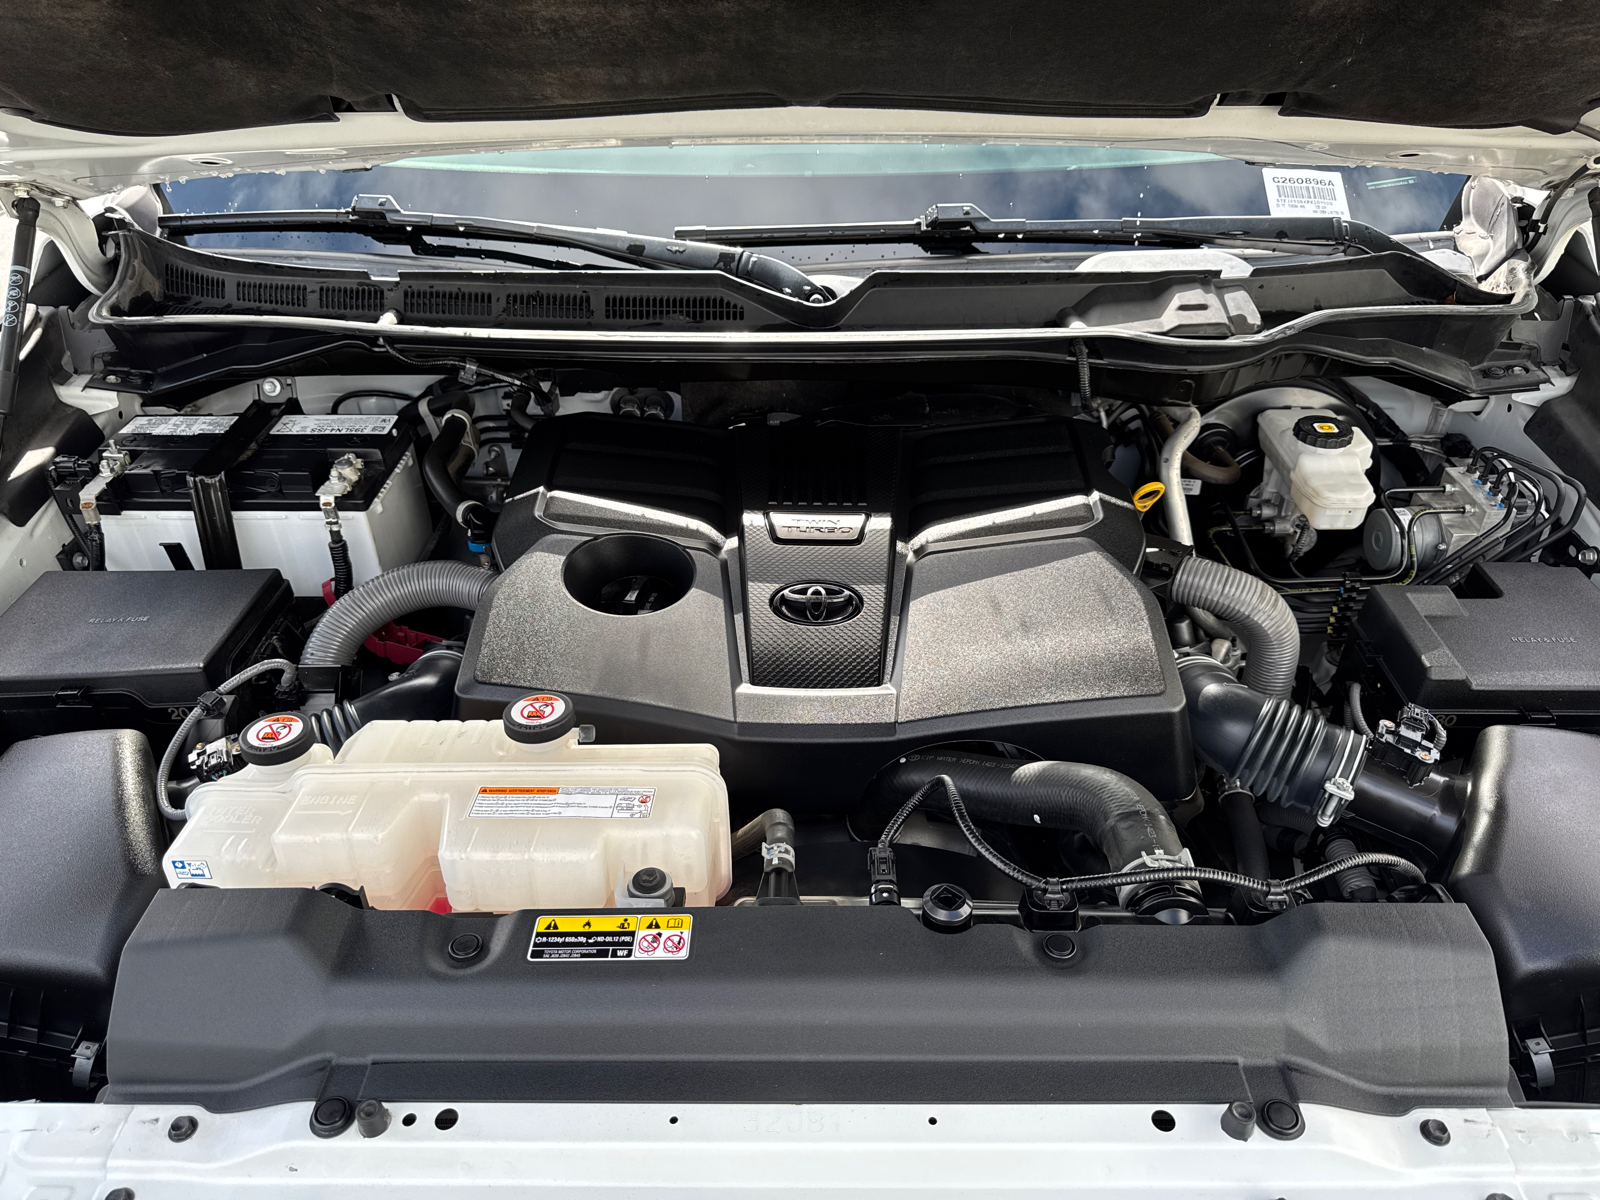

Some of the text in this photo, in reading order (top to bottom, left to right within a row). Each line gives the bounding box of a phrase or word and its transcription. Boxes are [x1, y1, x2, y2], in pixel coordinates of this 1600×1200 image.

[791, 518, 841, 526] TWIN
[782, 525, 854, 534] TURBO
[299, 795, 358, 805] ENGINE
[209, 805, 256, 816] INTER
[205, 814, 263, 824] COOLER
